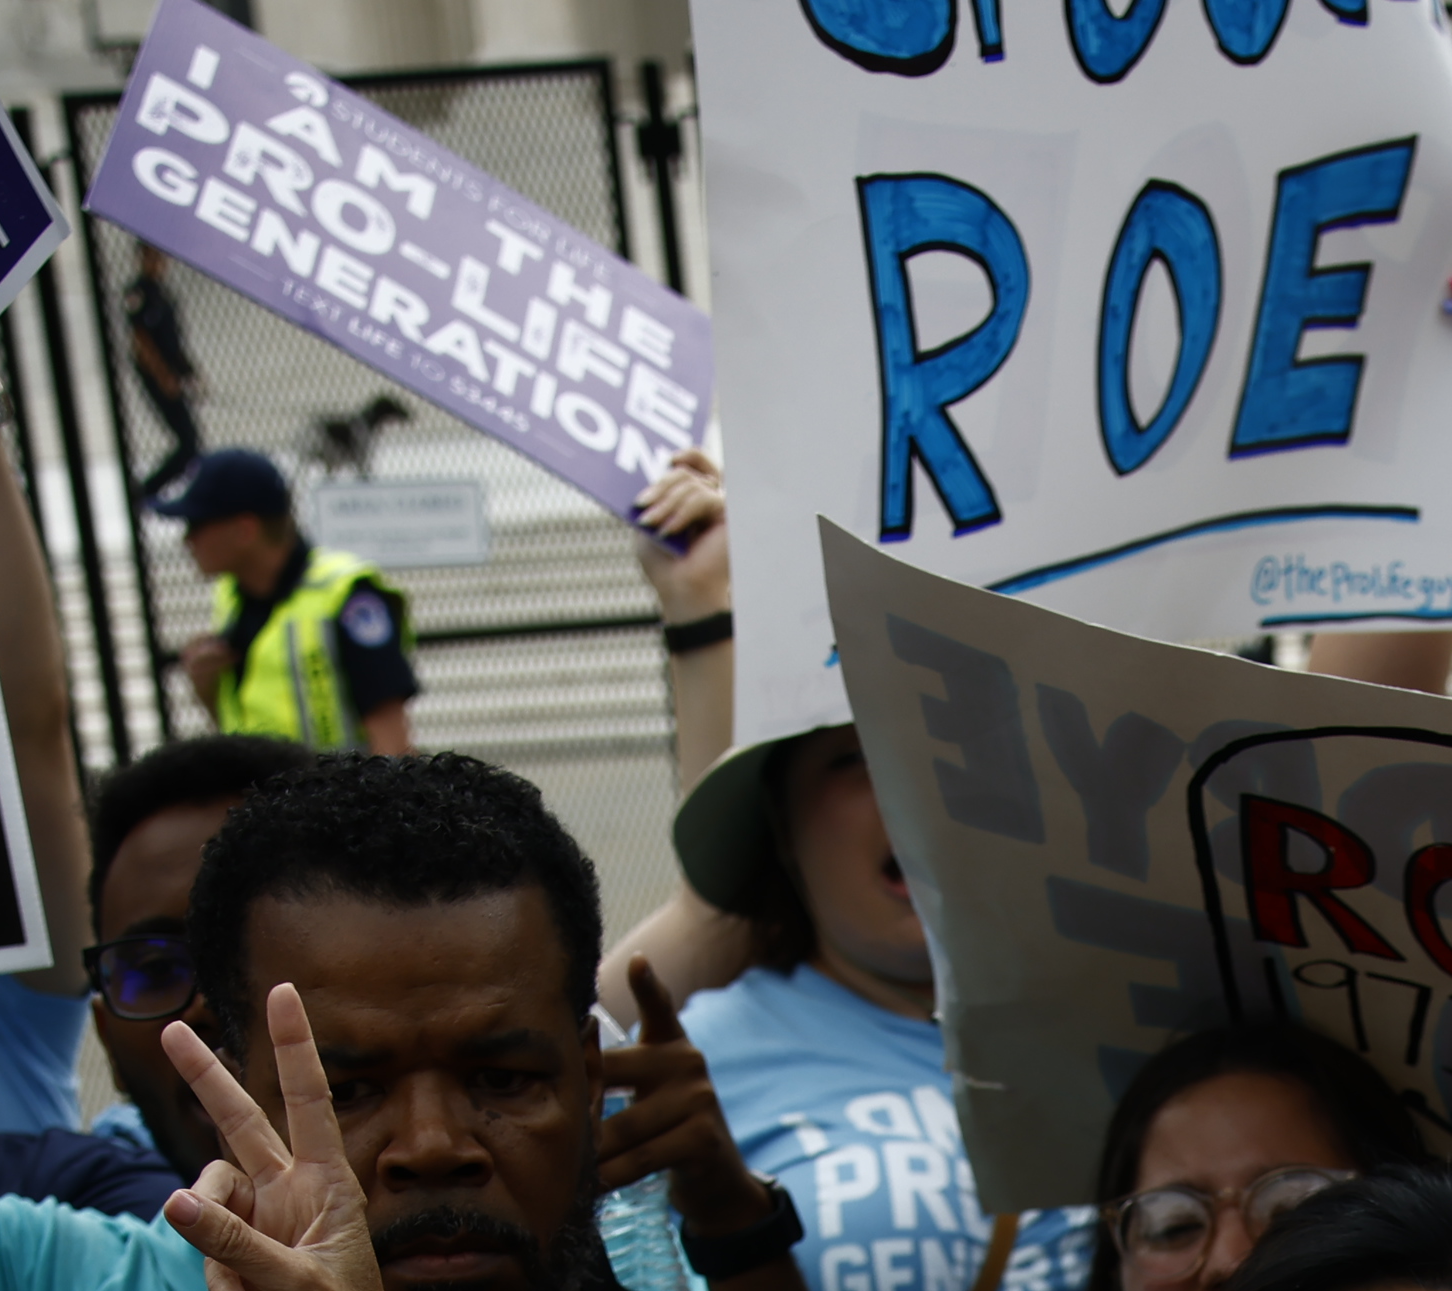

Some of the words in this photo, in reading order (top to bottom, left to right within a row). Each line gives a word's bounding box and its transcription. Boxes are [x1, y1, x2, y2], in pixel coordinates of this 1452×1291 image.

[132, 147, 673, 485] GENERATION
[135, 72, 699, 447] PRO-LIFE
[187, 44, 221, 90] I
[265, 106, 437, 220] AM
[485, 219, 676, 369] THE
[281, 276, 342, 322] TEXT
[348, 316, 403, 359] LIFE
[409, 351, 446, 382] TO
[449, 375, 531, 434] 53445
[331, 101, 483, 202] STUDENTS
[487, 195, 551, 242] FOR
[555, 237, 613, 283] LIFE
[855, 134, 1419, 541] ROE
